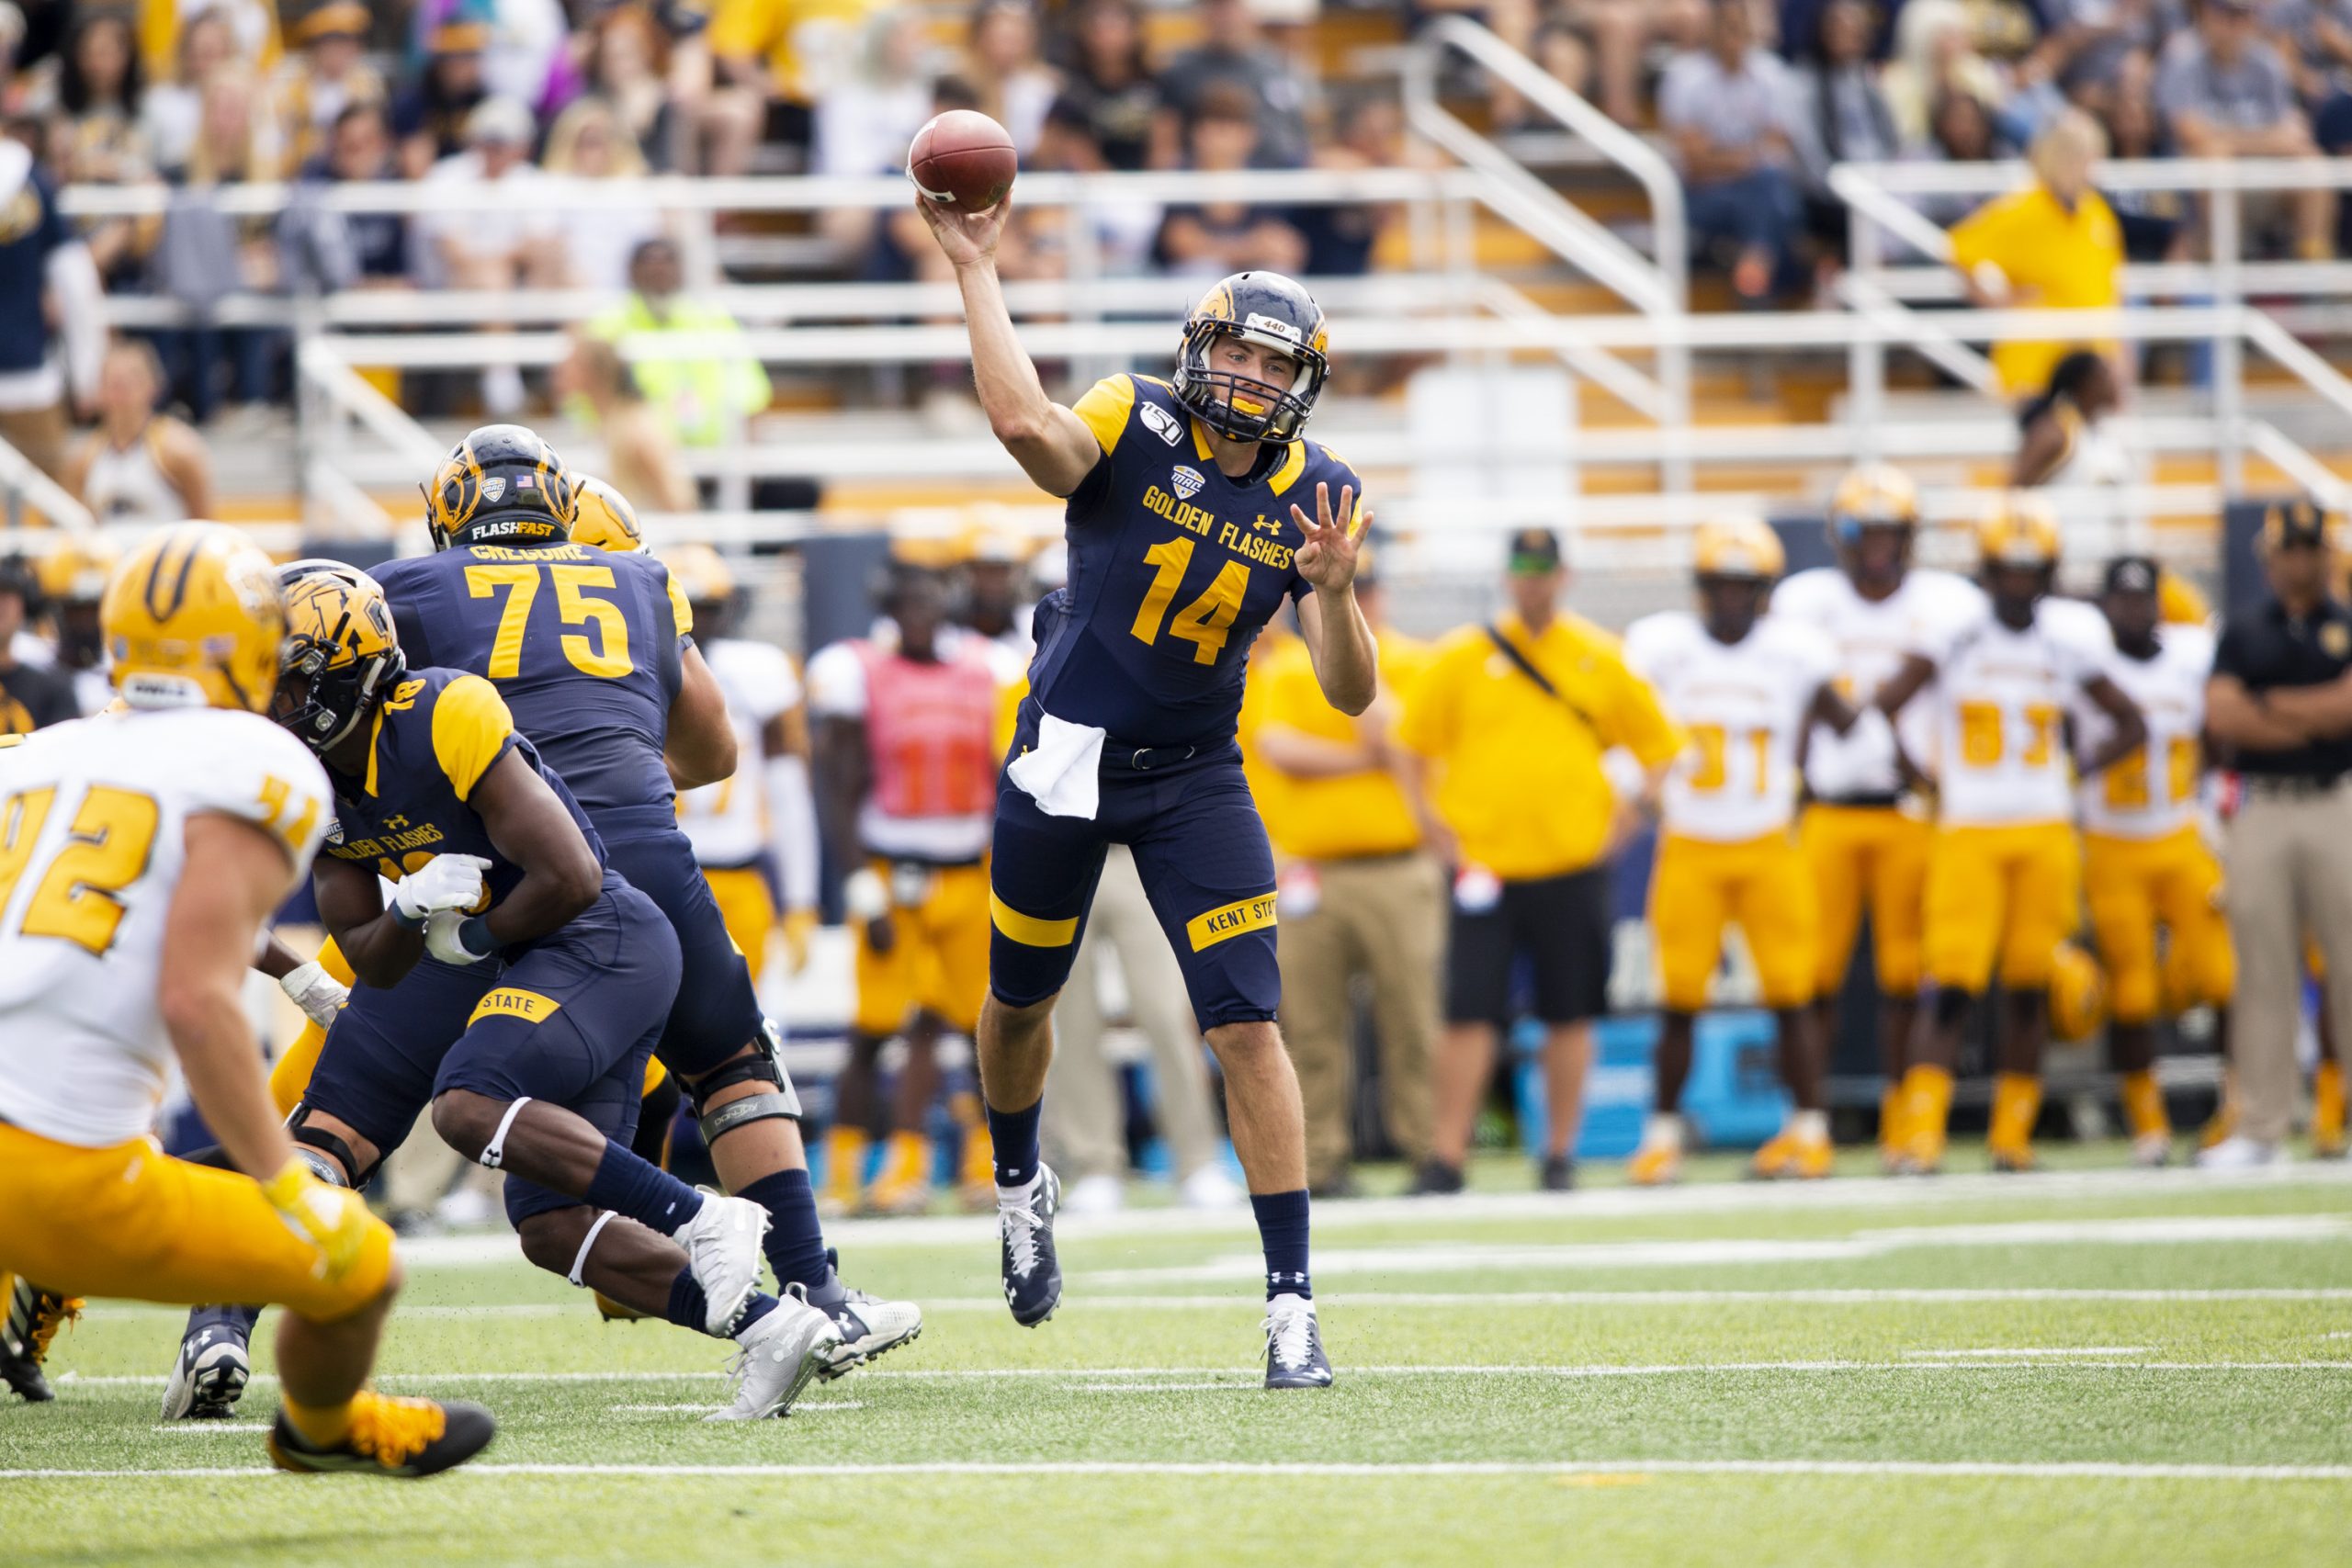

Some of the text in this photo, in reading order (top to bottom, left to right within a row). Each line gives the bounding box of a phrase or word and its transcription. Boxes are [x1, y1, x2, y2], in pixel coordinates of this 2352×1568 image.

[1264, 321, 1285, 333] 440
[1142, 401, 1183, 446] 150
[1171, 472, 1203, 492] MAC
[471, 521, 555, 540] FLASHFAST
[1142, 485, 1295, 570] GOLDEN FLASHES
[1130, 536, 1251, 666] 14
[464, 564, 634, 679] 75
[383, 678, 427, 716] 18
[379, 822, 445, 852] FLASHES
[1206, 907, 1247, 933] KENT
[483, 994, 535, 1013] STATE
